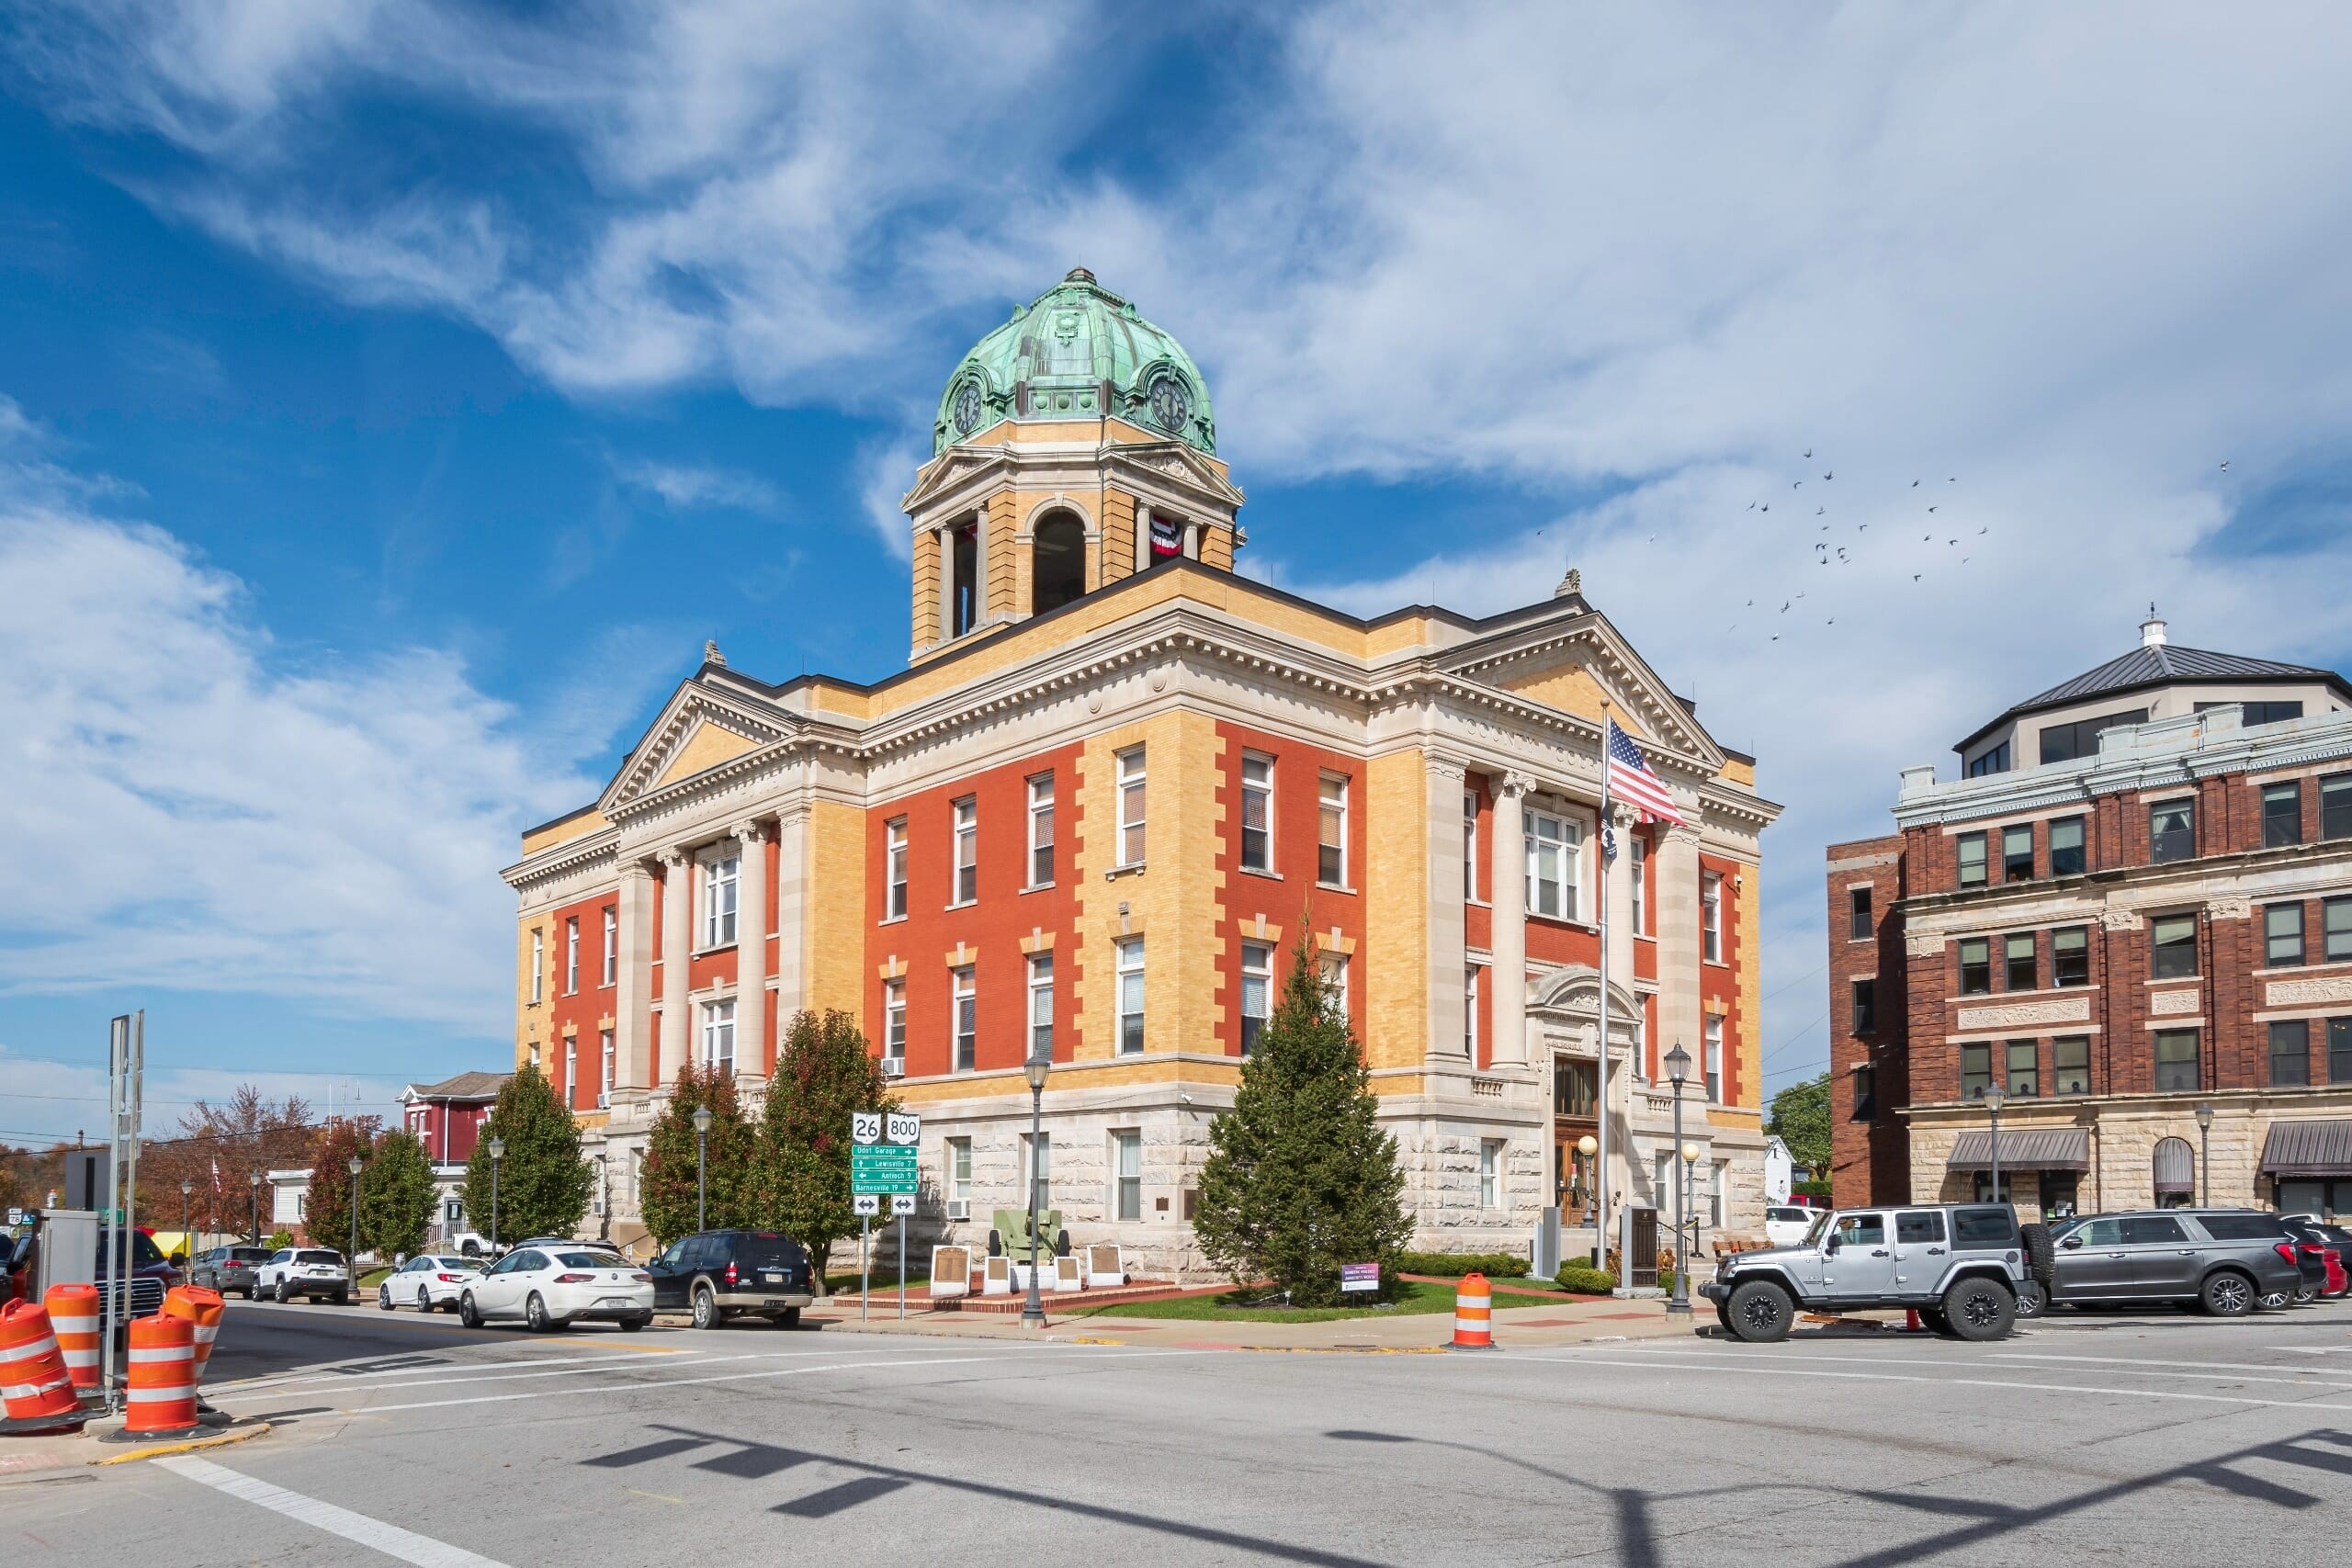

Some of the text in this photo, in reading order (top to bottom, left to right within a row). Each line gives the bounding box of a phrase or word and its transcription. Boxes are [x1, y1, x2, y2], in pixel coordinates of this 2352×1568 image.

[1466, 718, 1537, 753] COUNTY
[856, 1119, 877, 1136] 26
[891, 1120, 916, 1135] 800
